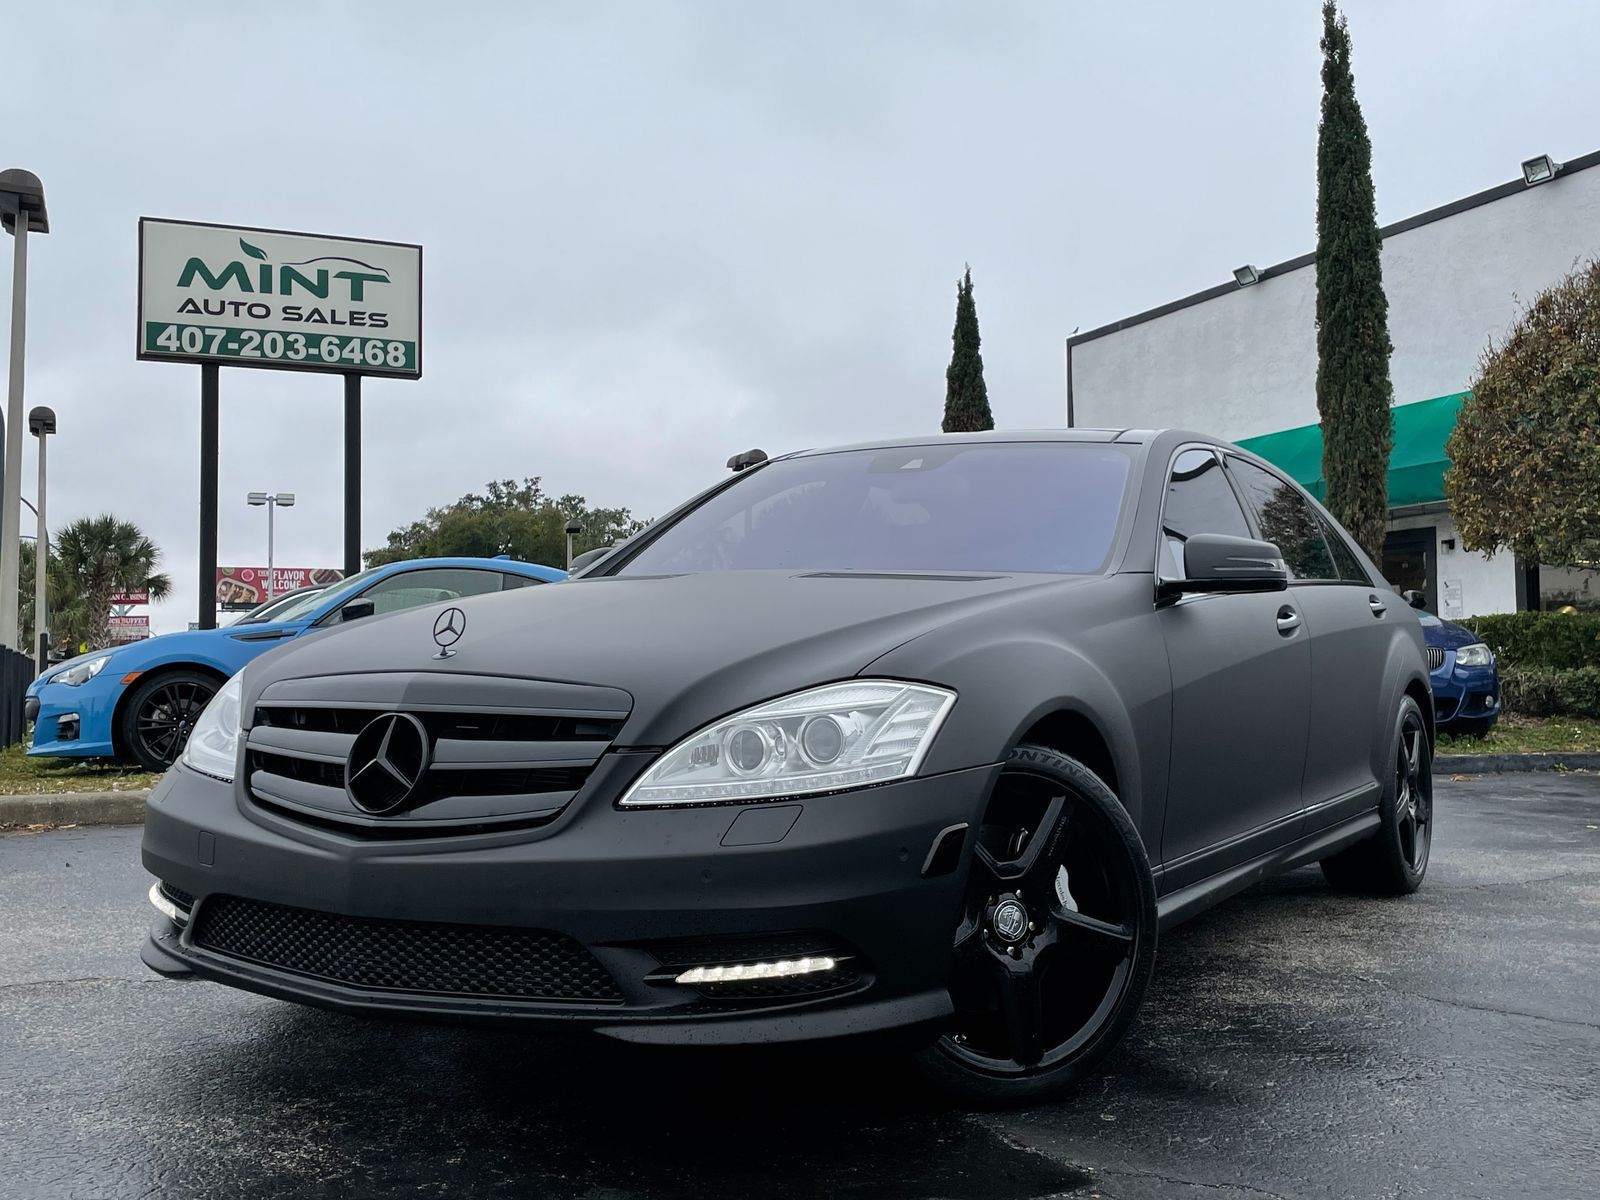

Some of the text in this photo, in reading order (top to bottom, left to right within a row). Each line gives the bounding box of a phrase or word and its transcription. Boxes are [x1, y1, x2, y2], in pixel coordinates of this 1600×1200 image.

[176, 257, 391, 302] MINT
[177, 297, 389, 328] AUTO SALES
[156, 325, 406, 367] 407-203-6468
[261, 580, 301, 590] WLCOME
[273, 570, 305, 580] FLAVOR
